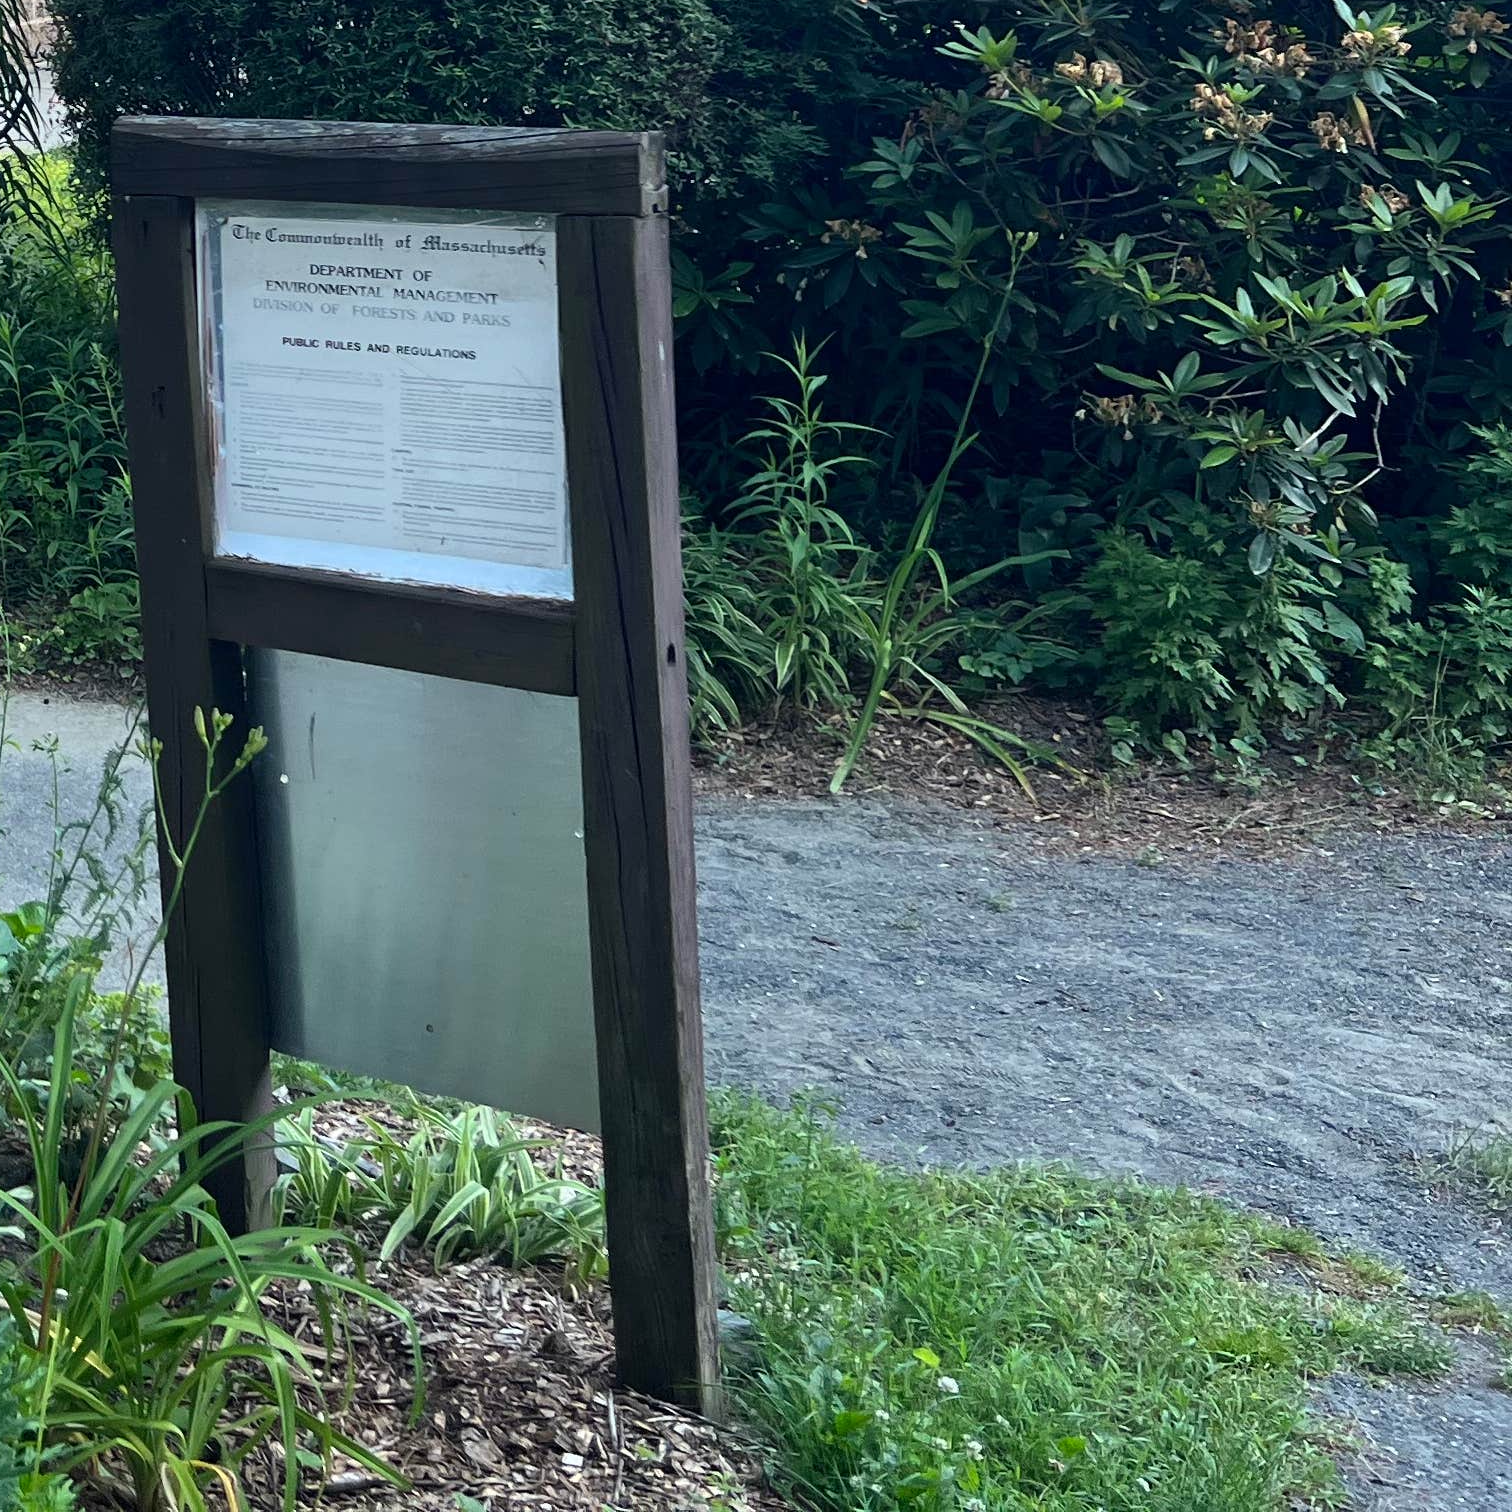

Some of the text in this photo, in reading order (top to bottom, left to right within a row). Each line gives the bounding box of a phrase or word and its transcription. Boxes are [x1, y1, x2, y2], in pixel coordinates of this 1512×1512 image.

[232, 223, 546, 257] The Commonwealth of Massachusetts
[310, 264, 432, 282] DEPARTMENT OF
[266, 280, 498, 305] ENVIRONMENTAL MANAGEMENT
[253, 297, 511, 327] DIVISION OF FORESTS AND PARKS
[282, 336, 476, 360] PUBLIC RULES AND REGULATIONS
